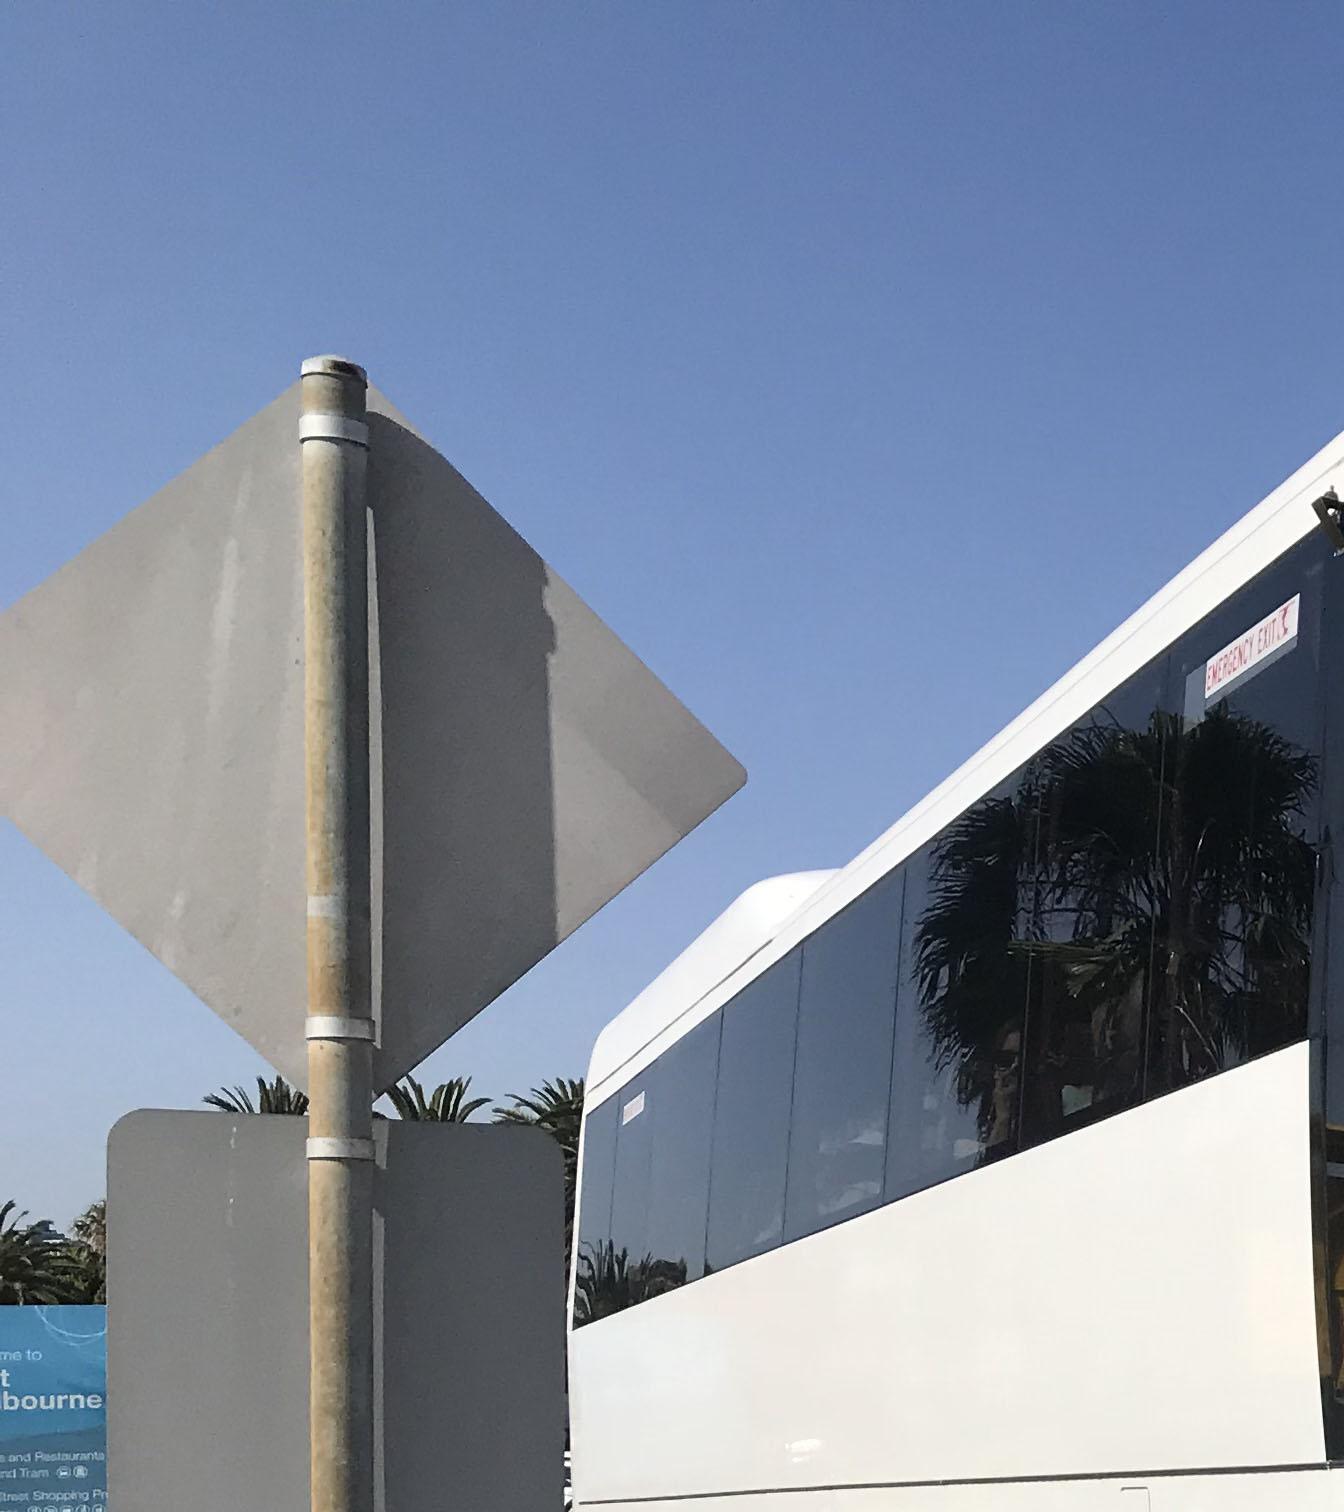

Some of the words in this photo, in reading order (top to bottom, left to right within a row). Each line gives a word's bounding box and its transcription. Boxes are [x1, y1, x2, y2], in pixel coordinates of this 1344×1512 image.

[25, 1349, 42, 1361] to
[0, 1391, 103, 1410] bourne
[19, 1467, 50, 1478] Tram
[33, 1490, 90, 1502] Shopping
